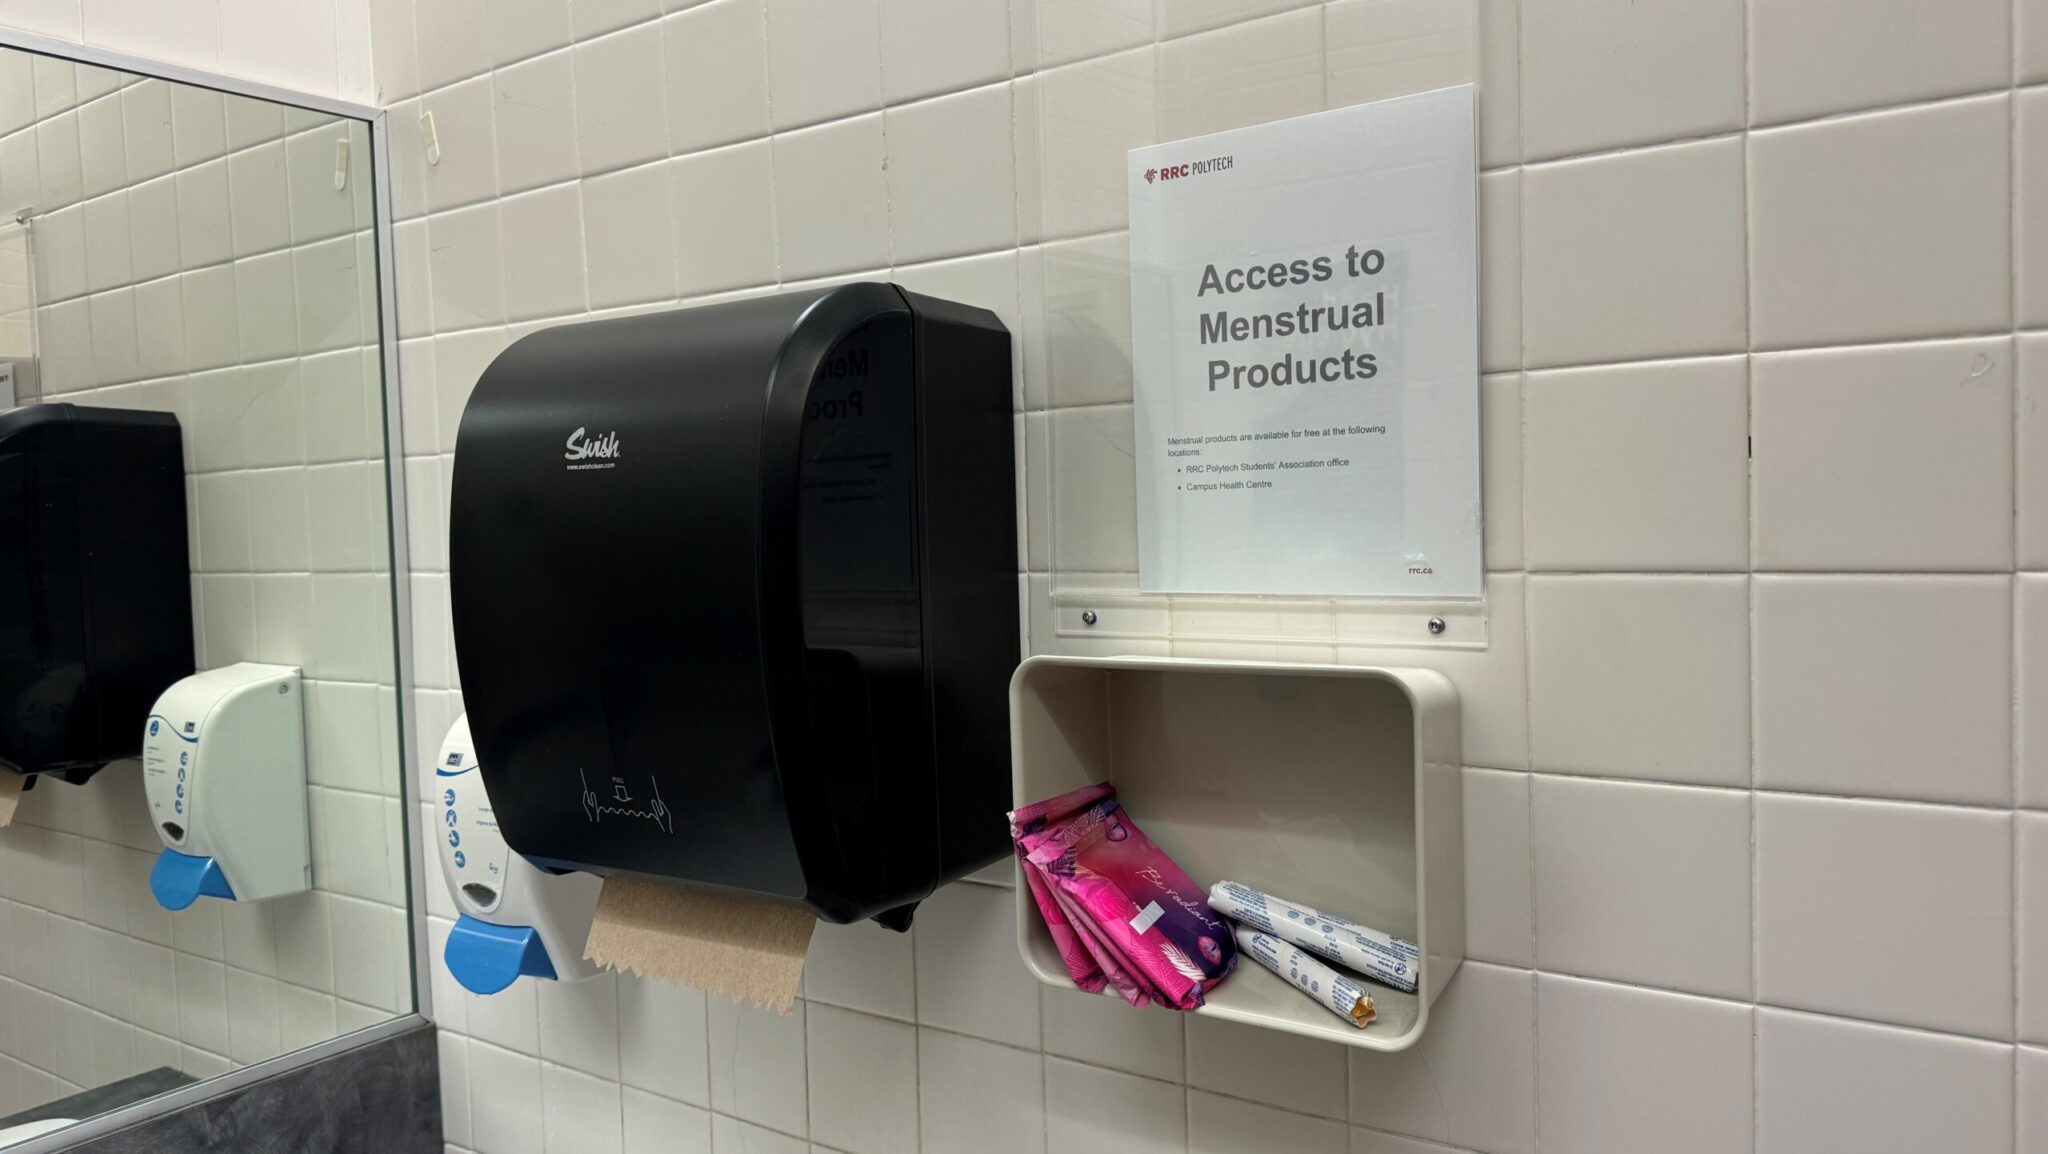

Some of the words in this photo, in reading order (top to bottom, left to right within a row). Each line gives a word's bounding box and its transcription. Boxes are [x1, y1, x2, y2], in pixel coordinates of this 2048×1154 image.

[1160, 164, 1189, 181] RRC
[1192, 155, 1233, 176] POLYTECH
[1197, 255, 1333, 297] Access
[1345, 244, 1385, 278] to
[1199, 292, 1385, 345] Menstrual
[1207, 348, 1378, 392] Products
[564, 426, 620, 460] Swish
[1167, 437, 1202, 446] Menstrual
[1204, 434, 1238, 444] products
[1239, 433, 1252, 441] are
[1254, 431, 1289, 440] available
[1291, 430, 1302, 438] for
[1303, 428, 1320, 438] free
[1322, 428, 1331, 436] at
[1332, 427, 1346, 436] the
[1348, 424, 1386, 435] following
[1167, 448, 1201, 457] locations:
[1186, 465, 1204, 474] RRC
[1206, 463, 1239, 474] Polytech
[1278, 459, 1325, 469] Association
[1326, 457, 1350, 468] office
[1186, 483, 1218, 492] Campus
[1219, 480, 1245, 490] Health
[1246, 479, 1273, 489] Centre
[1408, 566, 1433, 575] rrc.ca
